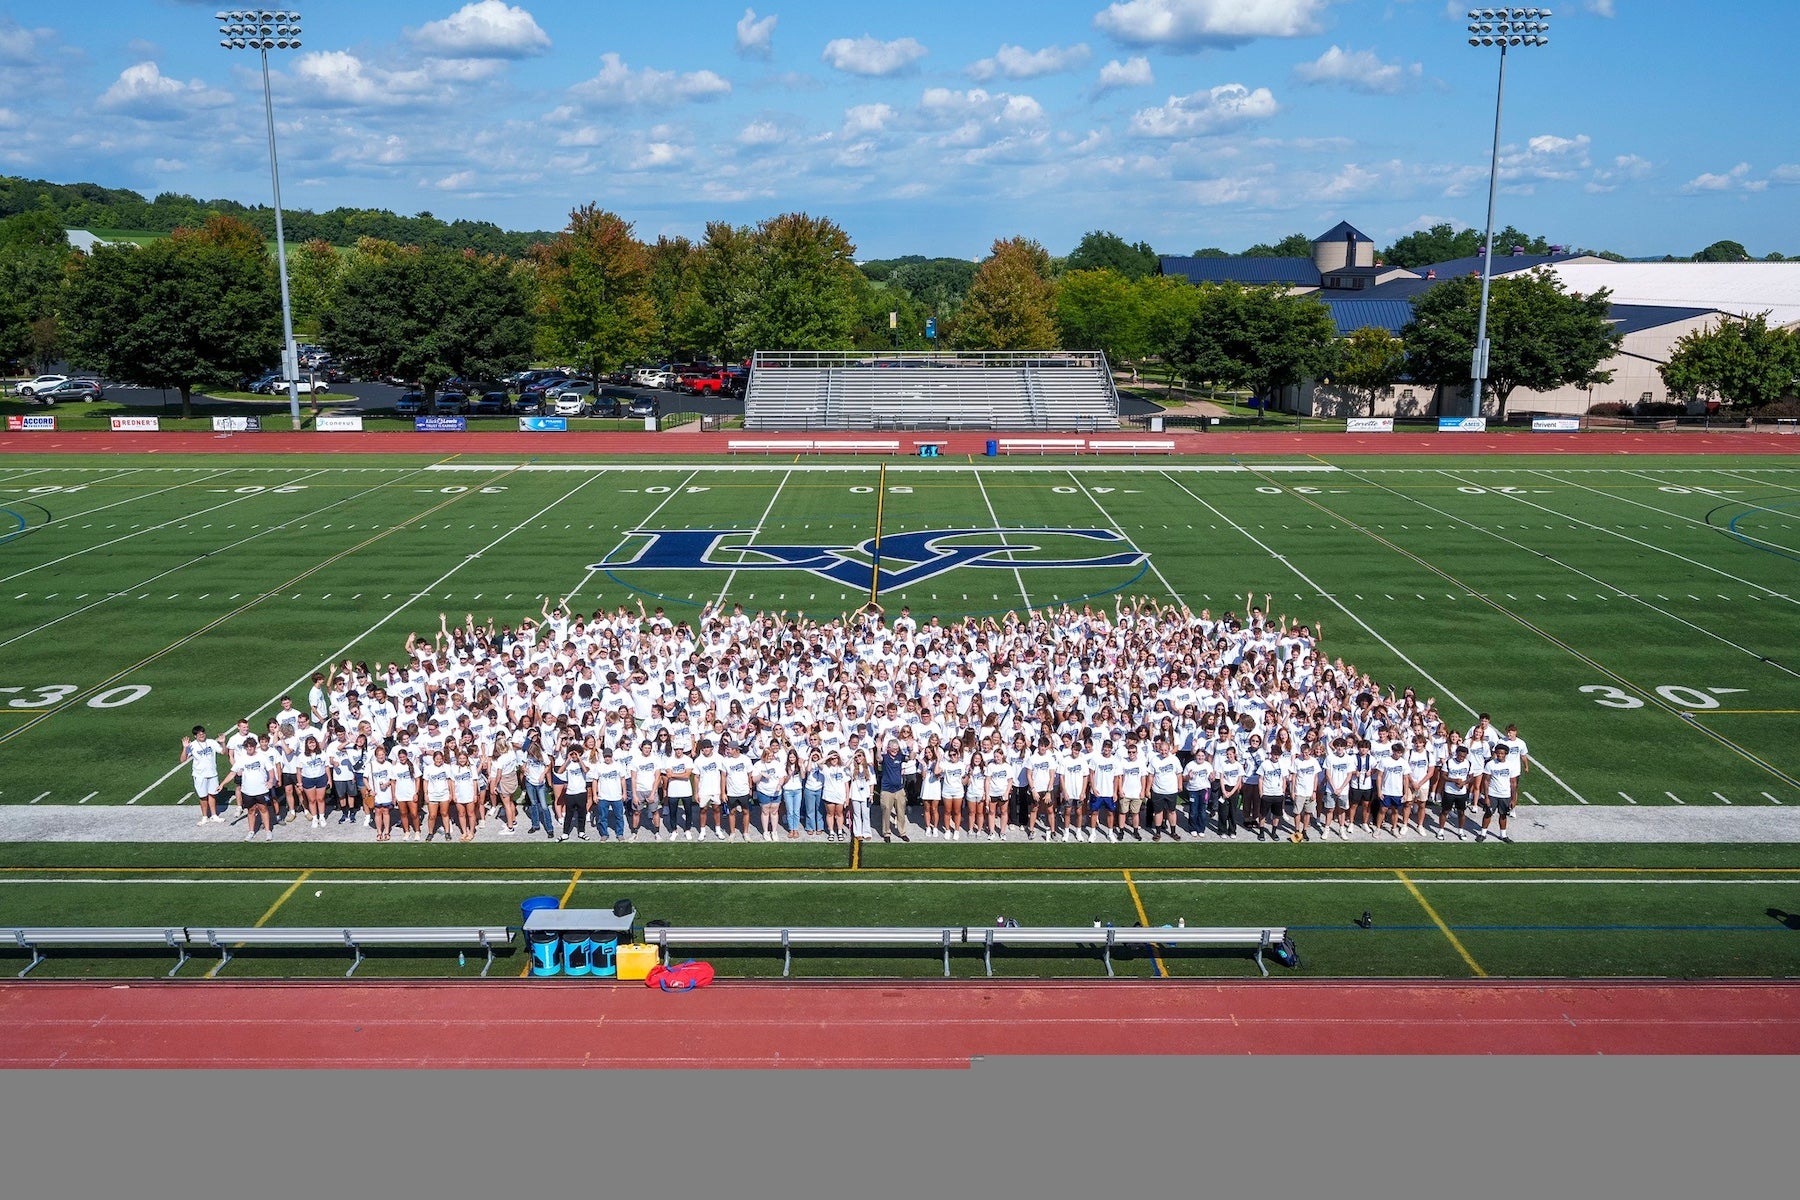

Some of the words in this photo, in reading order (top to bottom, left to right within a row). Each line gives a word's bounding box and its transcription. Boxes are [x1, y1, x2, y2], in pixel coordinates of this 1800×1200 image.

[1347, 419, 1378, 427] Corvette
[644, 486, 711, 494] 40
[849, 486, 914, 494] 50
[584, 527, 1152, 593] LVC
[8, 684, 152, 708] 30
[1577, 684, 1720, 709] 30
